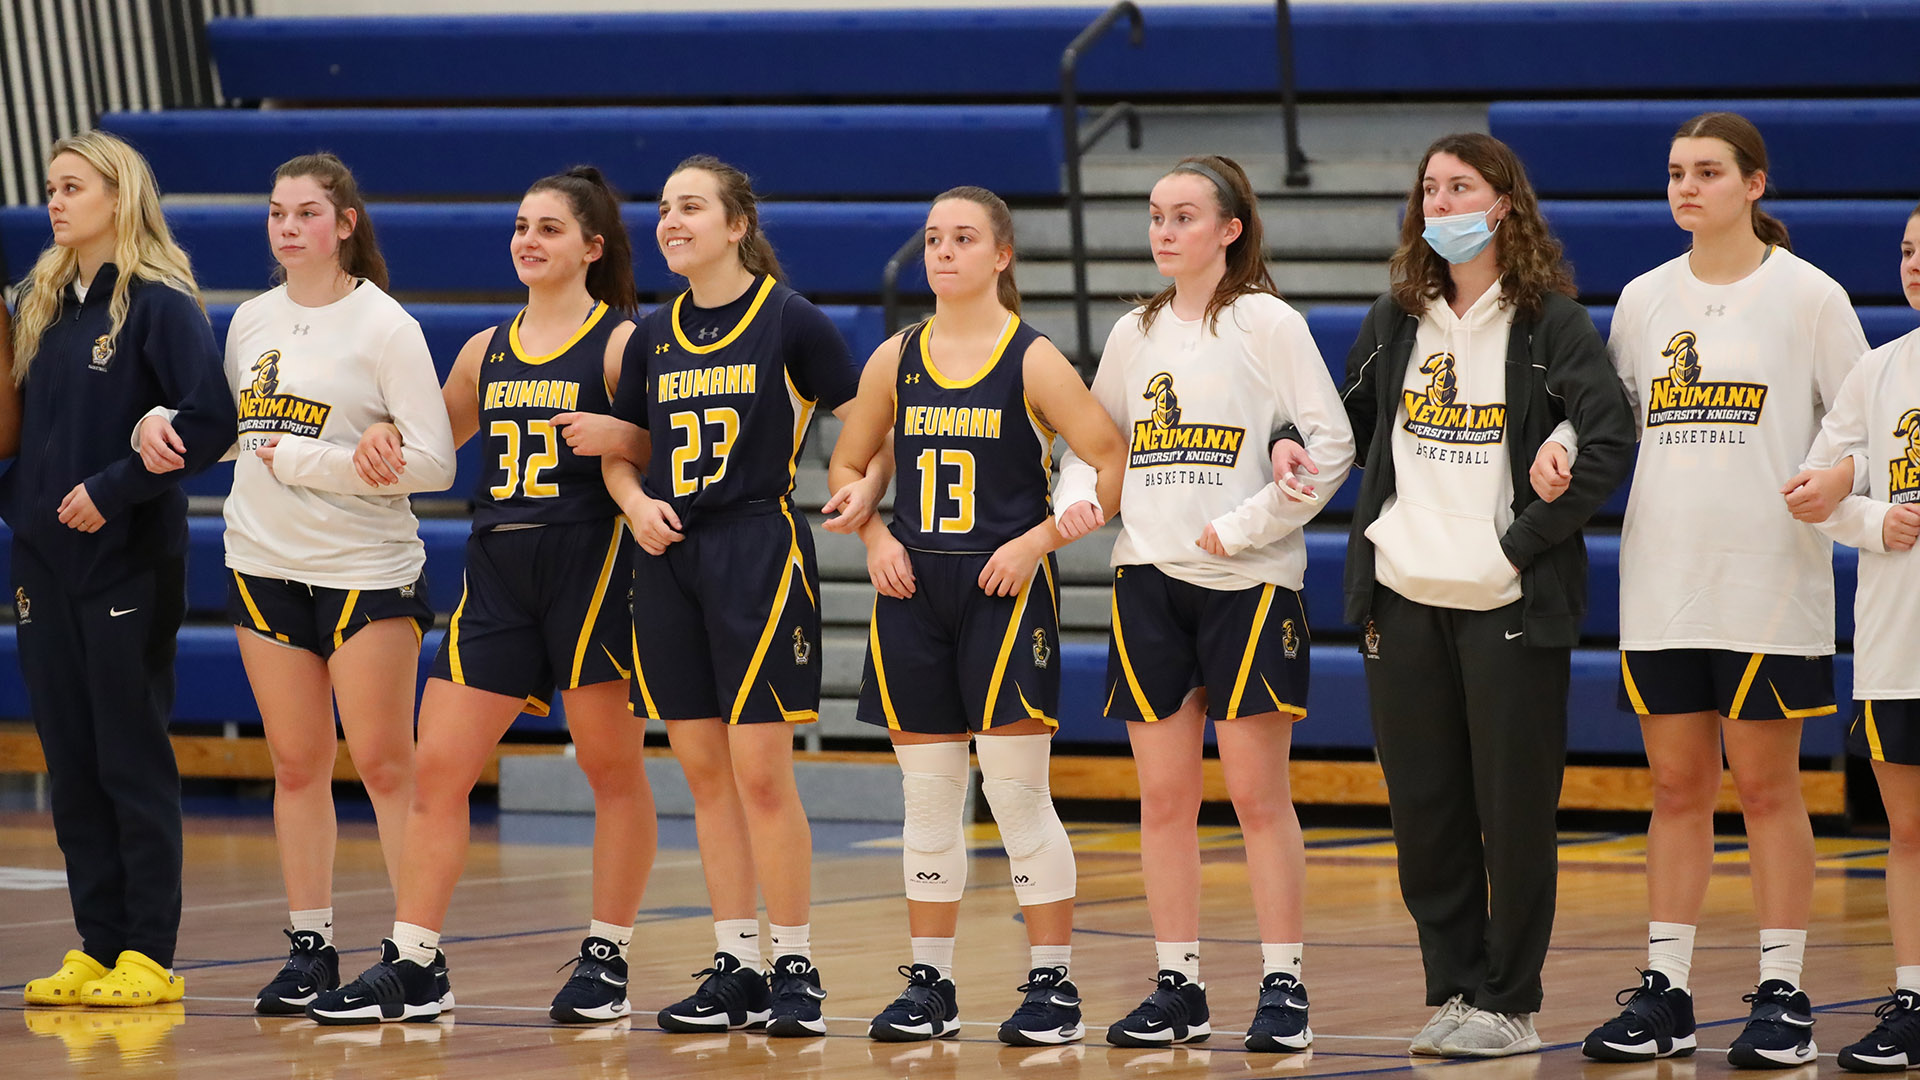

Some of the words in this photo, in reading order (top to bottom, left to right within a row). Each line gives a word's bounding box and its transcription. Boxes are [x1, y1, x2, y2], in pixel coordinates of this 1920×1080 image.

[484, 380, 580, 411] NEUMANN
[658, 364, 756, 403] NEUMANN
[1651, 380, 1764, 410] NEUMANN
[239, 391, 327, 425] NEUMANN
[904, 406, 1002, 438] NEUMANN
[1706, 409, 1757, 421] KNIGHTS
[1133, 422, 1242, 452] NEUMANN
[1456, 429, 1501, 441] KNIGHTS
[1660, 430, 1745, 444] BASKETBALL
[490, 419, 560, 501] 32
[669, 407, 740, 498] 23
[1185, 451, 1234, 464] KNIGHTS
[1416, 443, 1489, 464] BSKETBALL
[916, 448, 976, 534] 13
[1145, 471, 1223, 487] BASKETBALL
